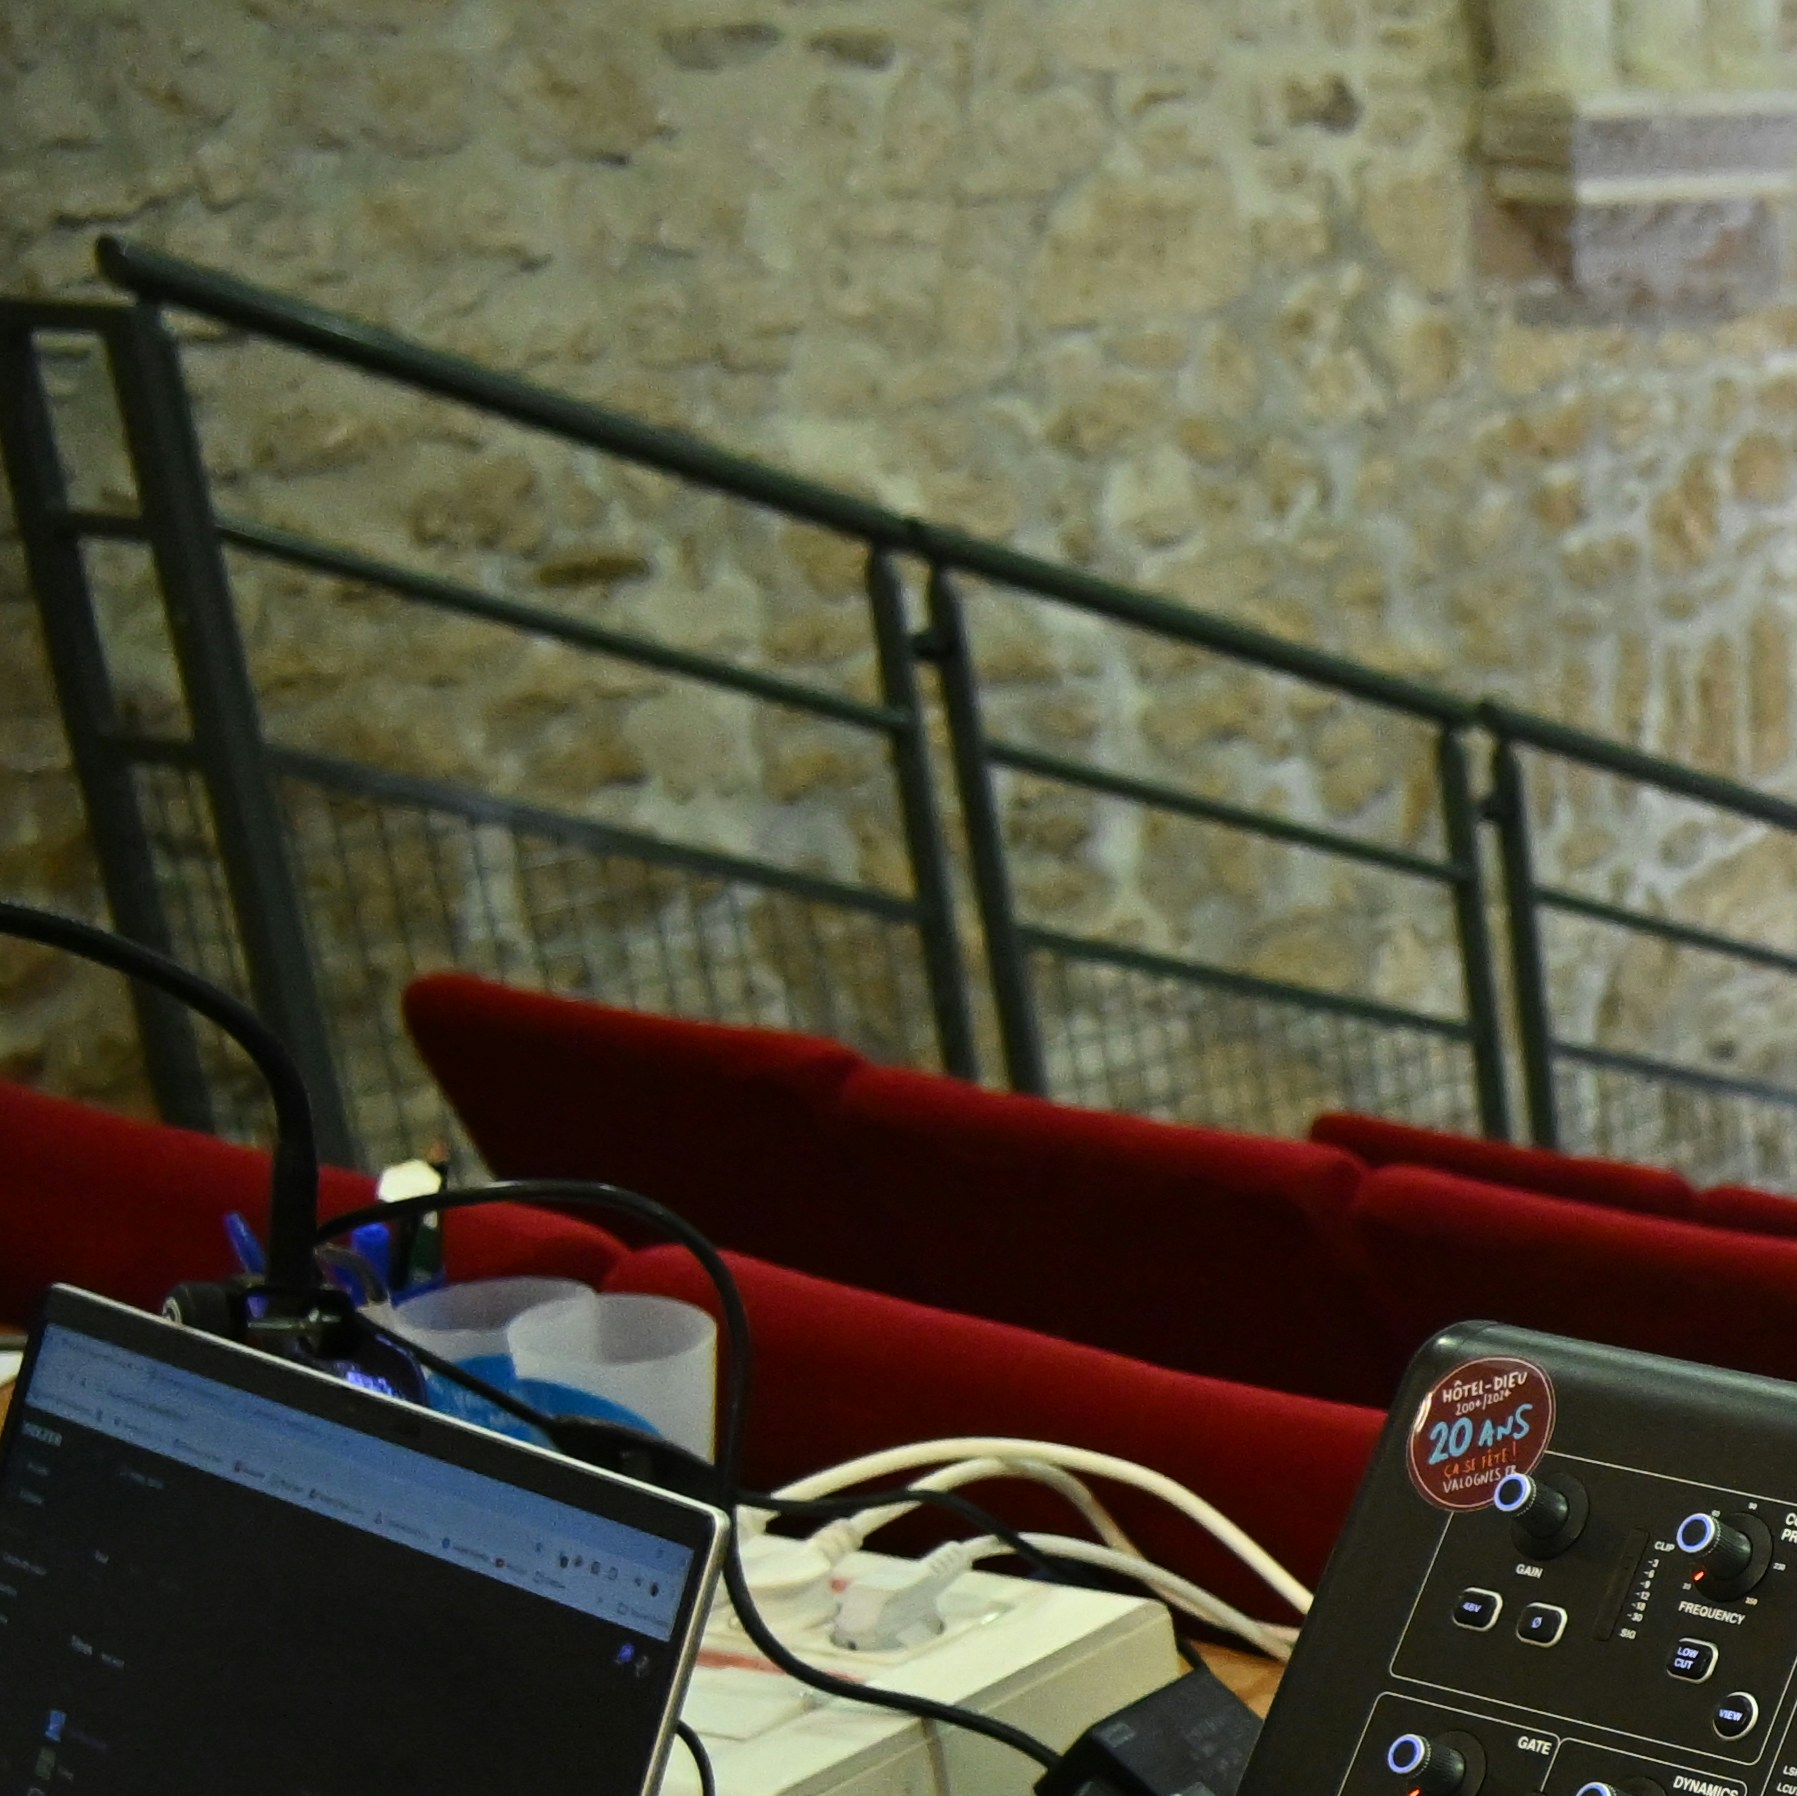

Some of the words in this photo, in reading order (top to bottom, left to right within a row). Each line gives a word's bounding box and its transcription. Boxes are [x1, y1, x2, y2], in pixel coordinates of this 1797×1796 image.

[1428, 1417, 1473, 1465] 20
[1479, 1403, 1533, 1447] ANS
[1444, 1464, 1460, 1480] ÇA
[1464, 1460, 1476, 1472] SE
[1654, 1540, 1676, 1552] CLIP
[1515, 1563, 1544, 1579] GAIN
[1678, 1600, 1746, 1625] FREQUENCY
[1676, 1646, 1699, 1659] LOW
[1673, 1657, 1694, 1670] CUT
[1718, 1709, 1743, 1722] VIEW
[1517, 1735, 1553, 1756] GATE
